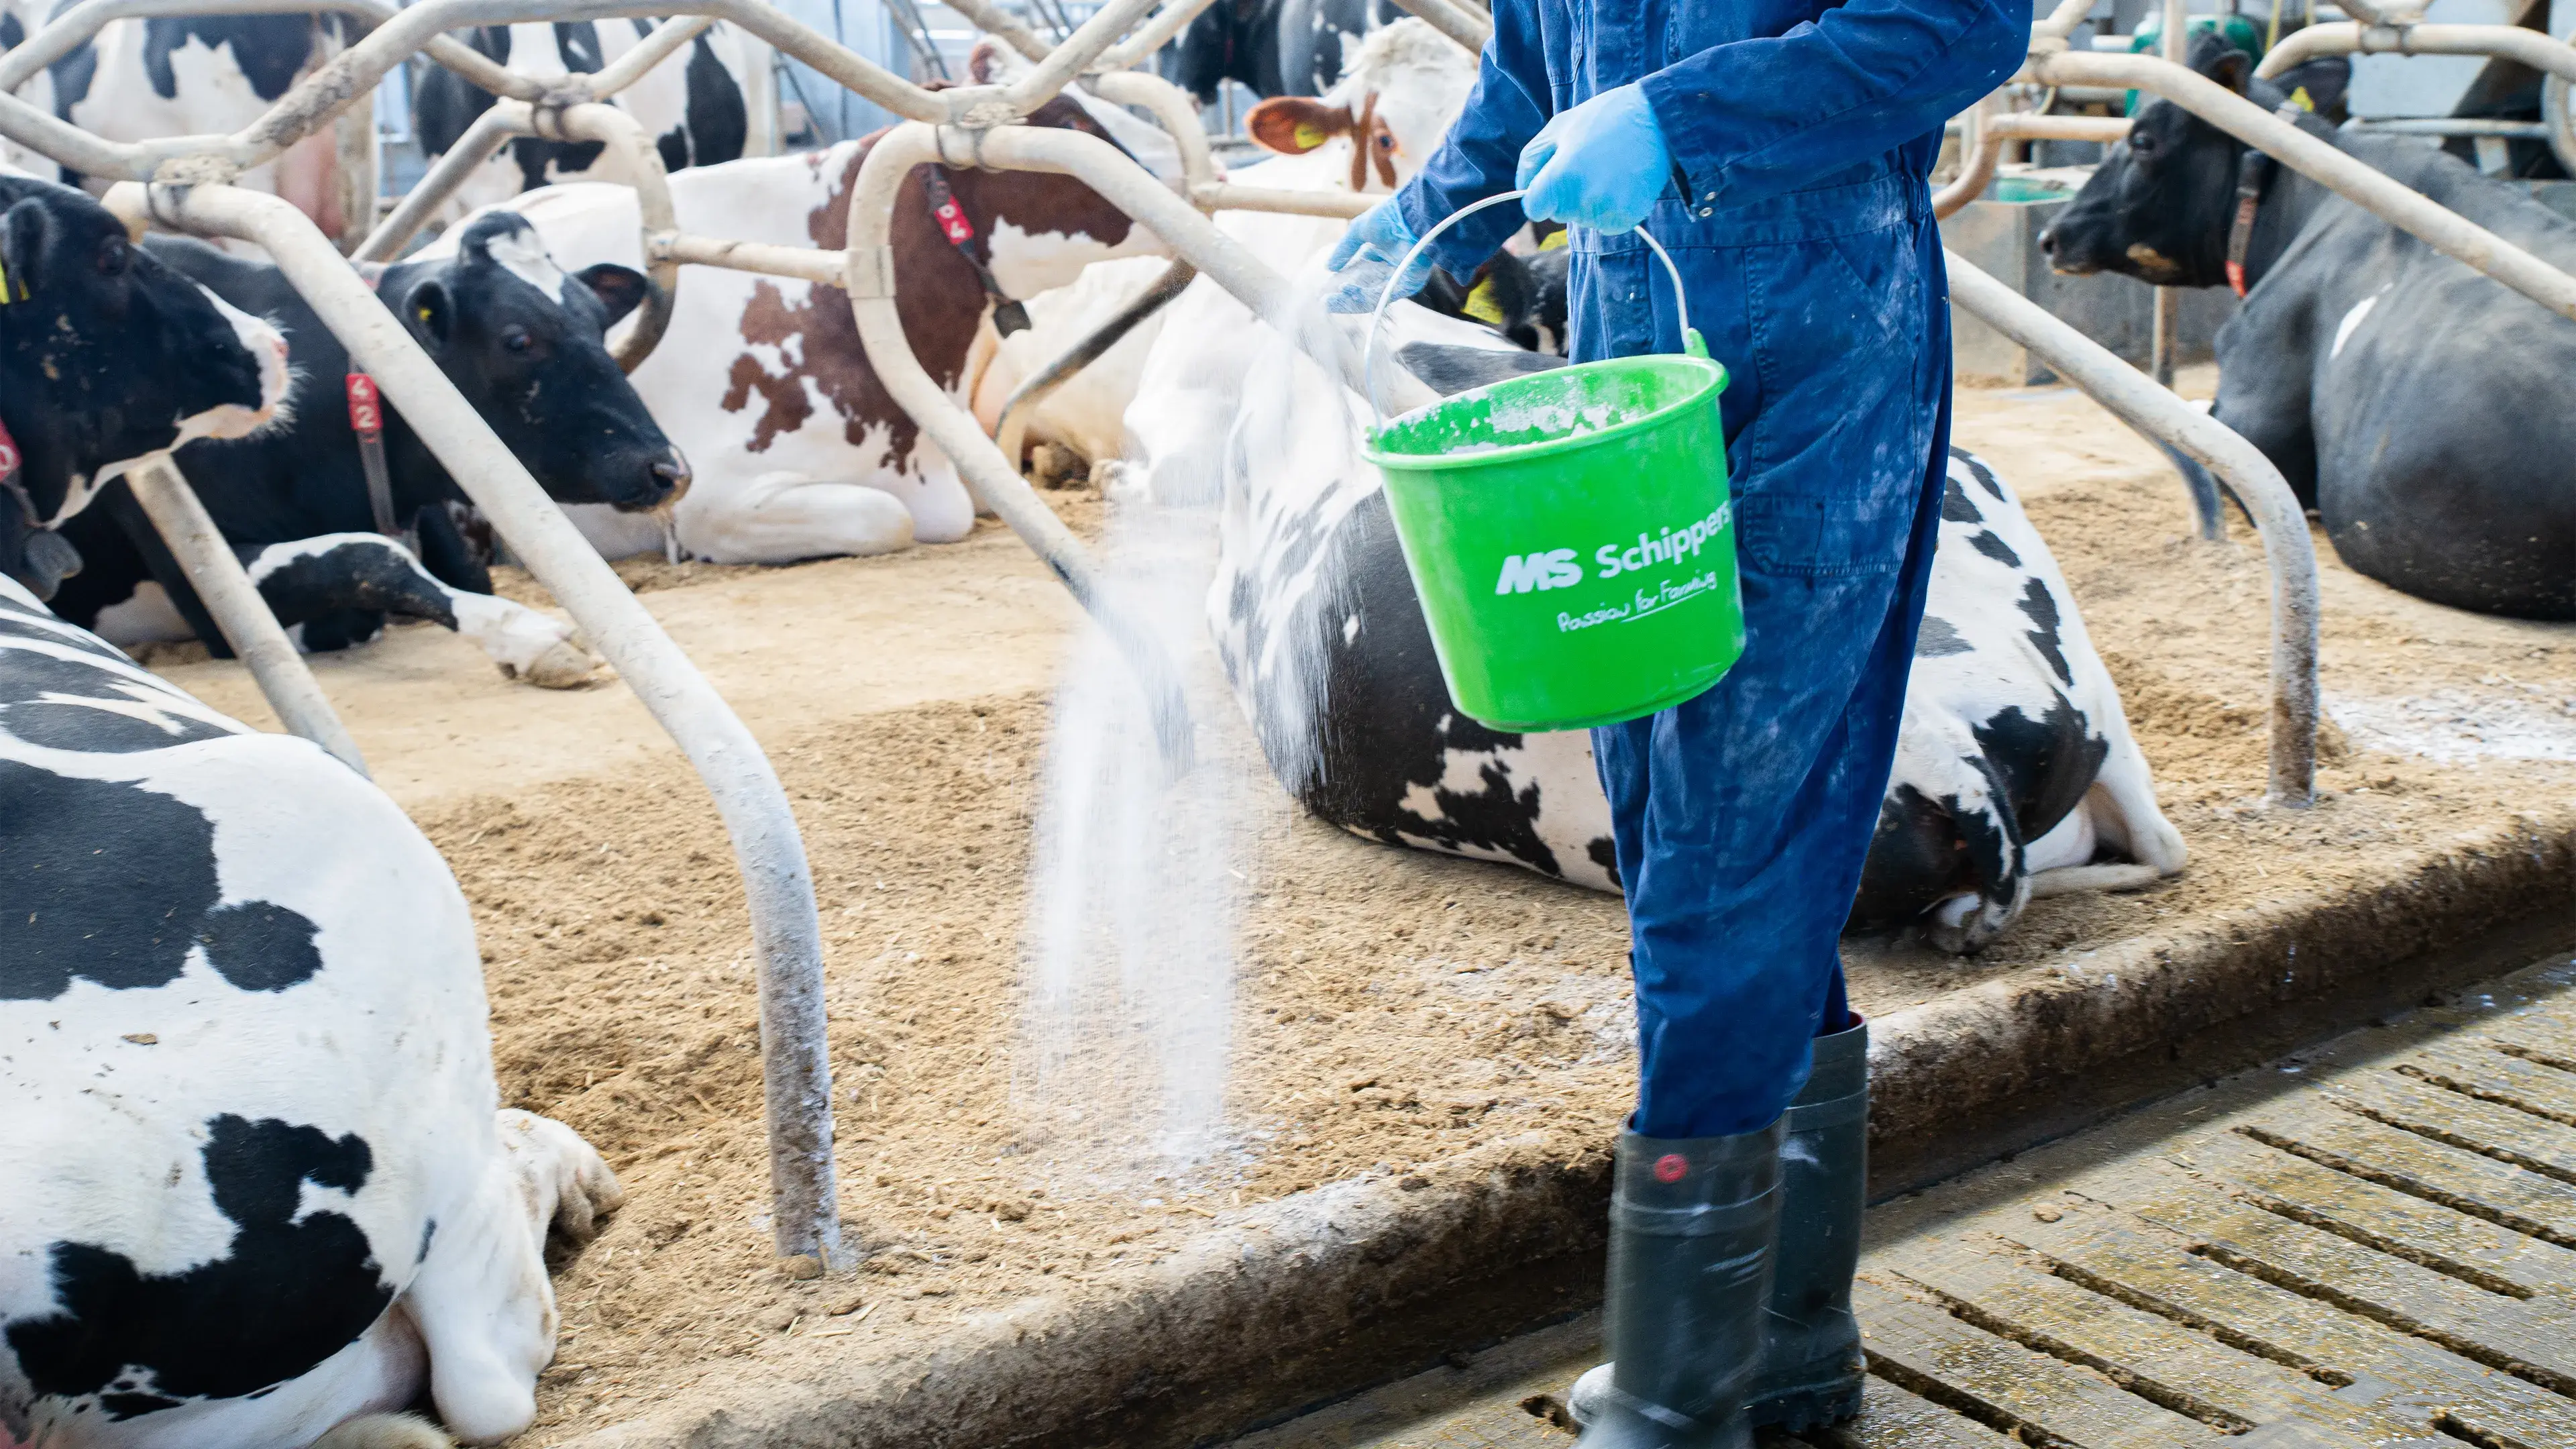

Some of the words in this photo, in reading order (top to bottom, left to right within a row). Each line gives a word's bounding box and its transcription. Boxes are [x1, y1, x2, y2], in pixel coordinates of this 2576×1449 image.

[1495, 547, 1583, 596] MS
[1557, 601, 1631, 633] Passion
[1635, 588, 1659, 614] for
[1660, 569, 1717, 602] Farming
